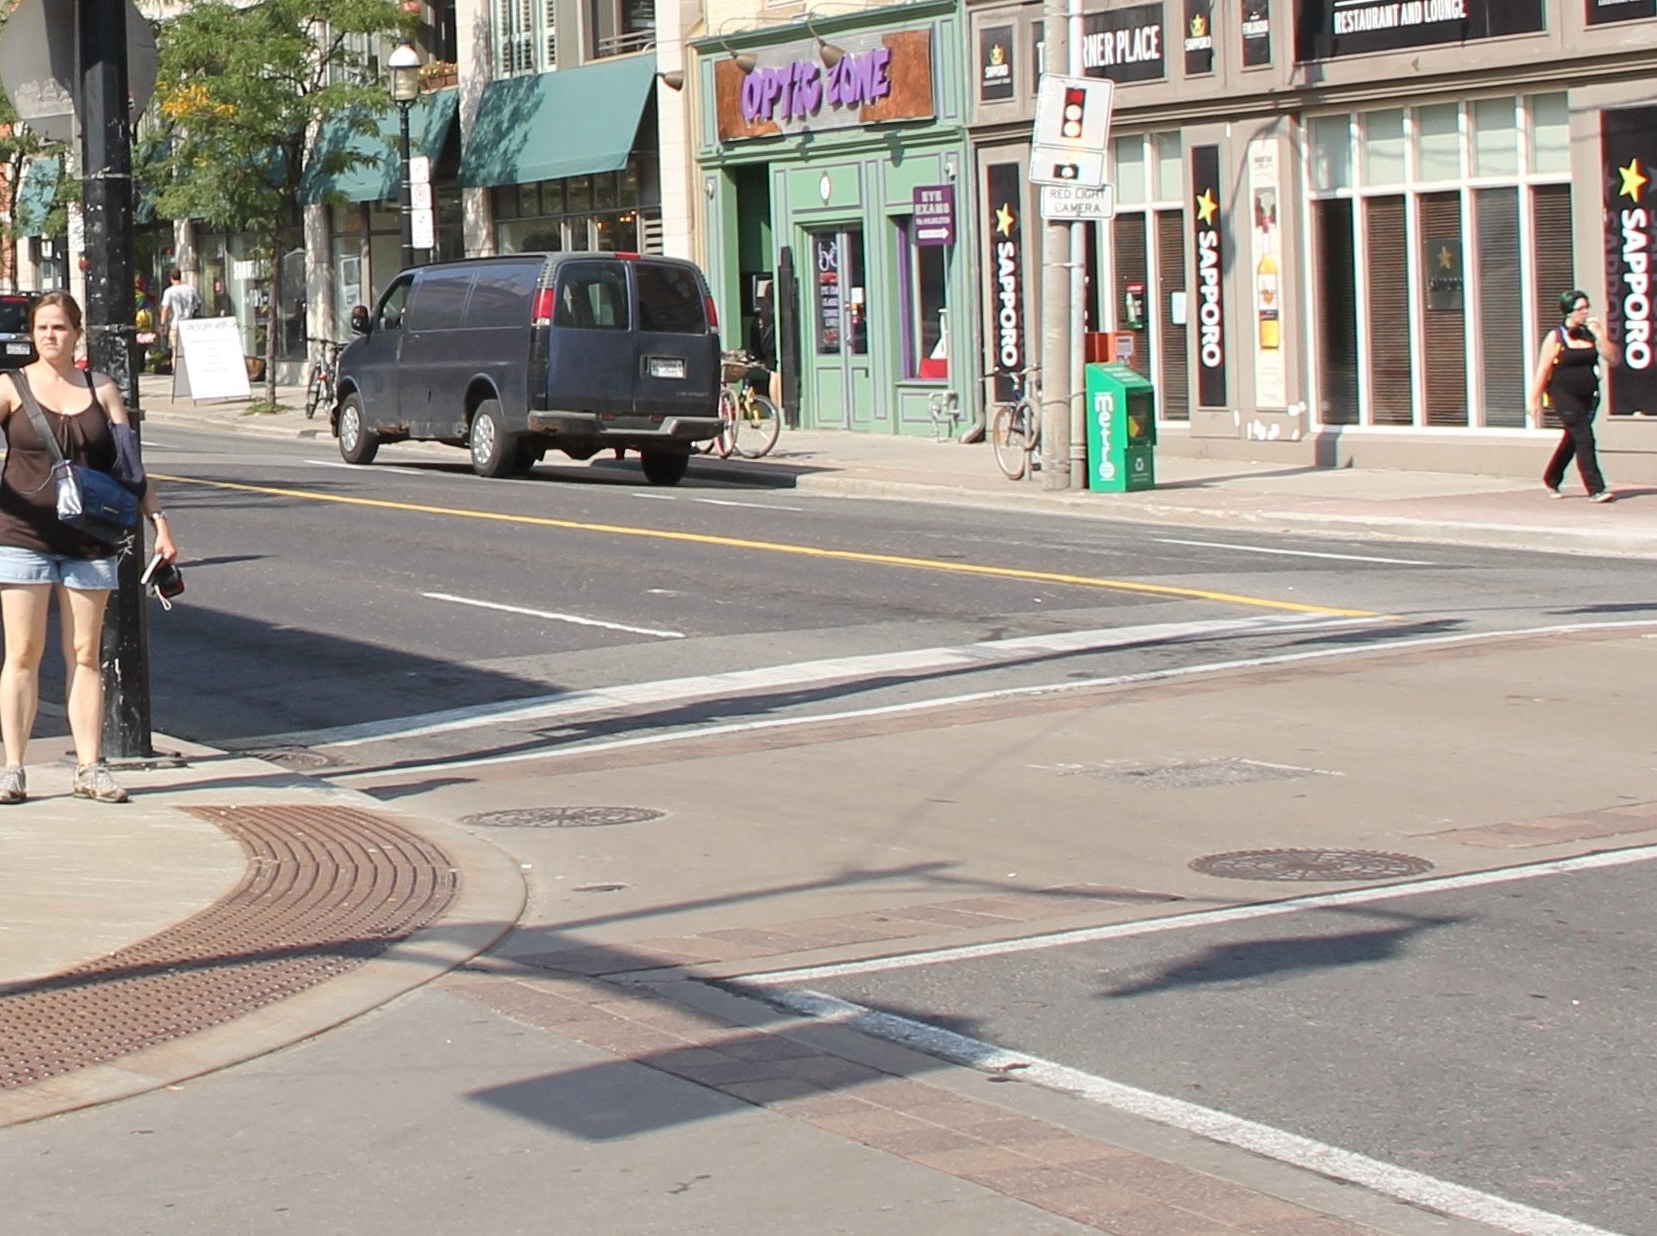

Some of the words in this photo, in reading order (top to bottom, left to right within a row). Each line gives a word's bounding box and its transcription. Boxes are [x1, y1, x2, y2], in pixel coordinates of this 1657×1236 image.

[1116, 25, 1160, 64] PLACE
[1334, 7, 1399, 35] RESTAURANT
[1400, 3, 1422, 27] AND
[1424, 0, 1466, 23] LOUNGE
[742, 60, 821, 121] OPTIC
[826, 48, 891, 105] ZONE
[1050, 188, 1071, 200] RED
[1075, 187, 1105, 200] LIGHT
[1055, 203, 1100, 214] CAMERA
[997, 241, 1019, 368] SAPPORO
[1199, 230, 1222, 368] SAPPORO
[1621, 208, 1651, 370] SAPPORO
